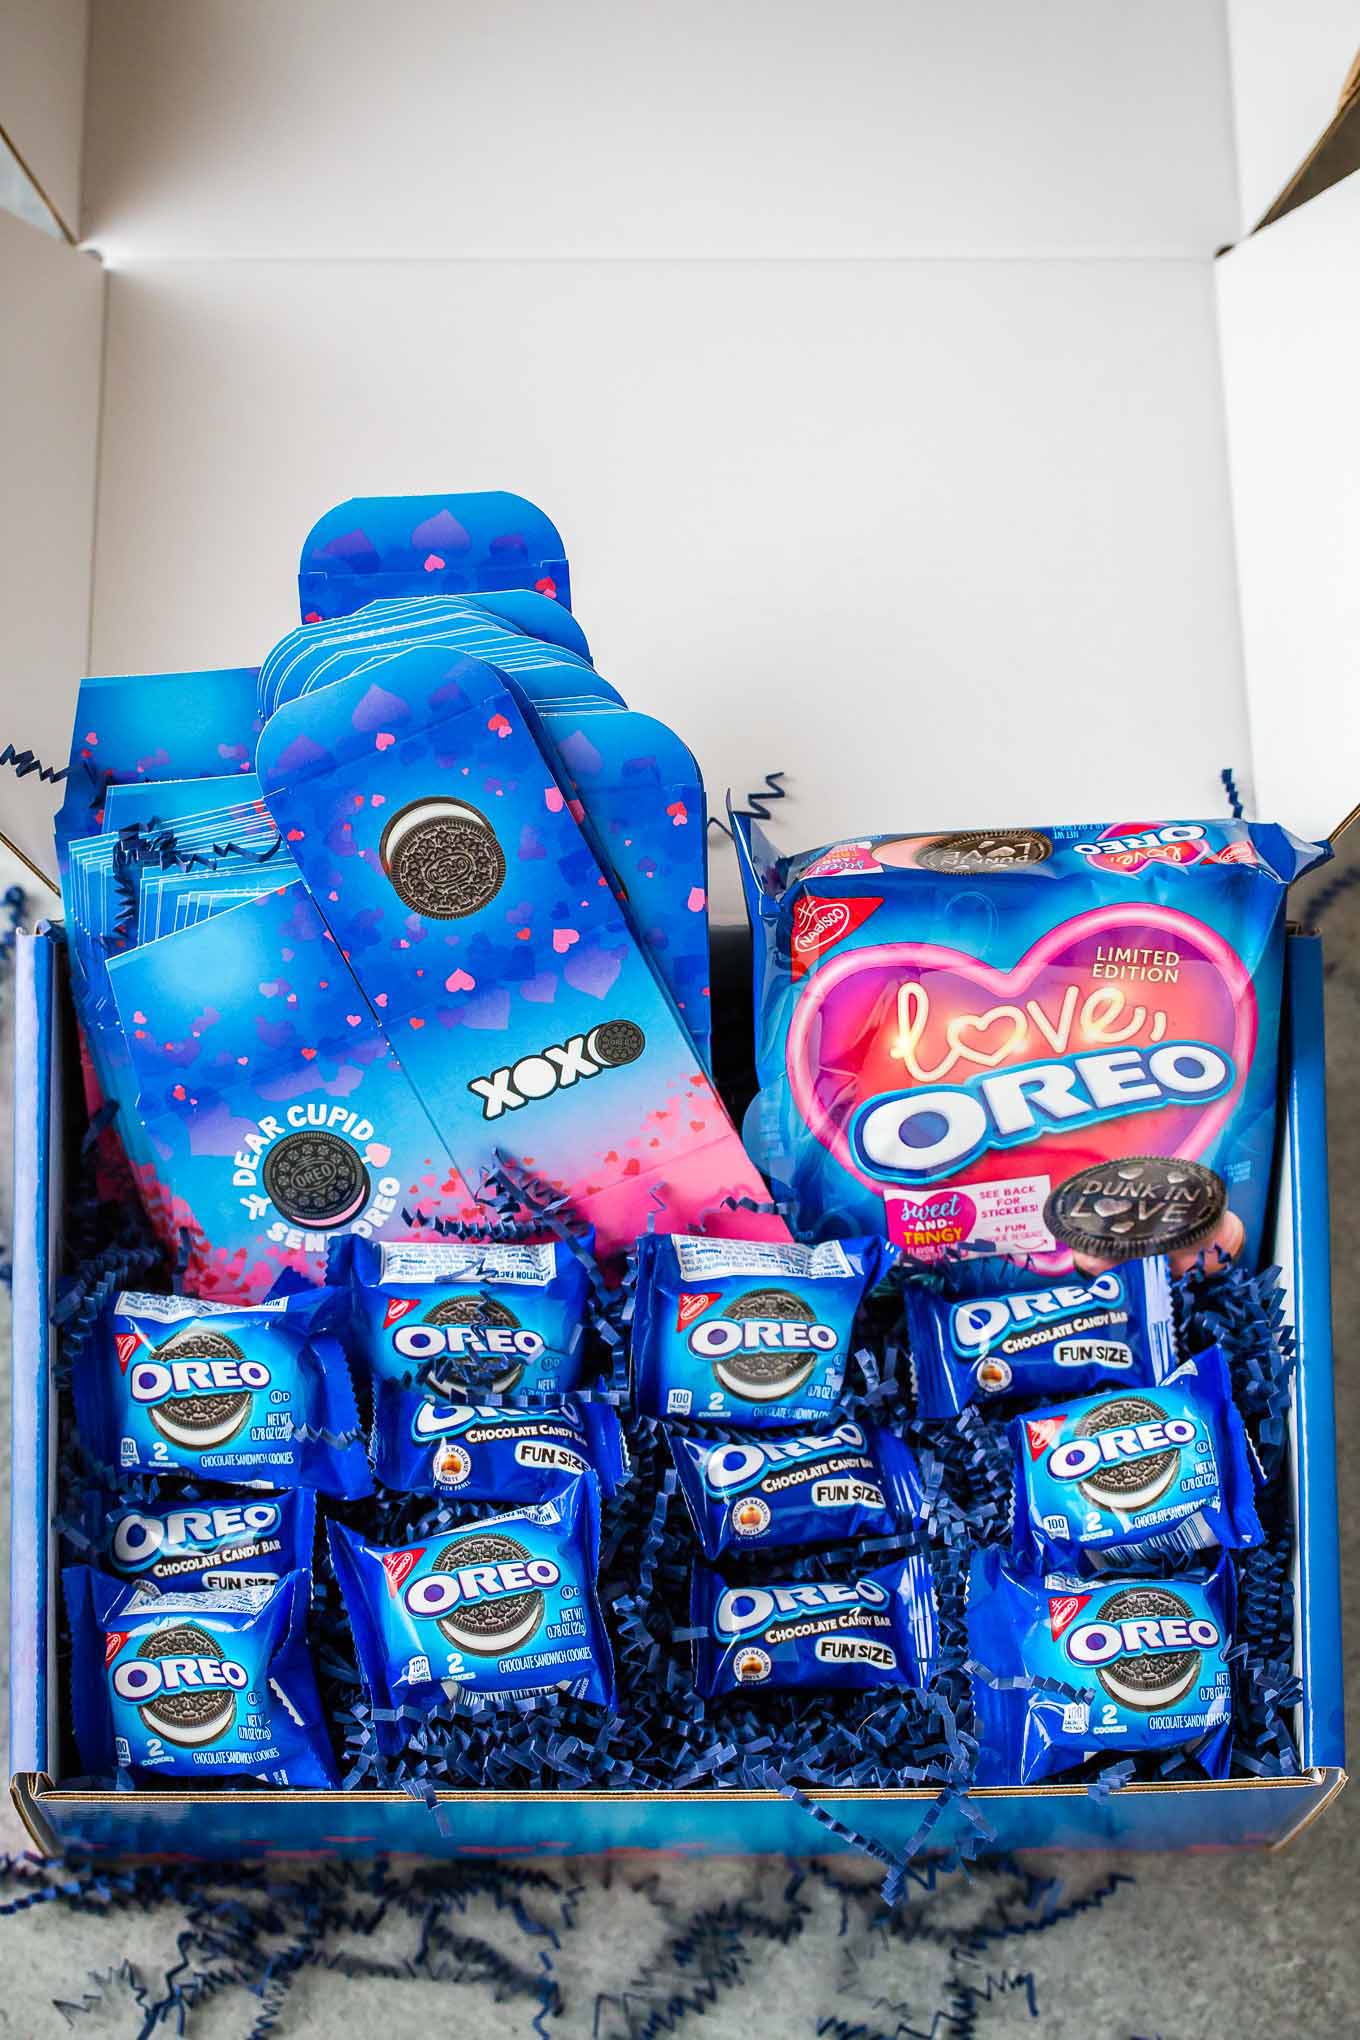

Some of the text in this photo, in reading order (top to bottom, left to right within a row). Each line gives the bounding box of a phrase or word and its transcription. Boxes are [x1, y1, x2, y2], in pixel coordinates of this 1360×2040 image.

[799, 907, 845, 947] NABISCO
[1096, 946, 1180, 967] LIMITED
[1092, 963, 1179, 983] EDITION
[861, 1044, 1227, 1171] OREO
[232, 1103, 375, 1187] DEAR CUPID
[294, 1163, 334, 1188] OREO
[1082, 1180, 1202, 1203] DUNK IN
[266, 1176, 401, 1253] SEN OREO
[902, 1194, 962, 1222] sweet
[903, 1226, 963, 1246] TANGY
[955, 1274, 1121, 1346] OREO
[393, 1325, 545, 1360] OREO
[691, 1320, 838, 1356] OREO
[1002, 1311, 1129, 1354] CHOCOLATE CANDY BAR
[1059, 1346, 1129, 1364] FUN SIZE
[131, 1360, 270, 1401] OREO
[672, 1392, 689, 1404] 100
[708, 1391, 725, 1411] 2
[267, 1413, 280, 1426] NET
[465, 1425, 538, 1442] CHOCOLATE
[539, 1424, 573, 1438] CANDY
[152, 1441, 169, 1461] 2
[201, 1451, 295, 1468] CHOCOLATE SANDWICH COOKIES
[520, 1444, 591, 1472] FUN SIZE
[707, 1424, 864, 1487] OREO
[1049, 1419, 1196, 1478] OREO
[761, 1465, 830, 1493] CHOCOLATE
[829, 1458, 861, 1474] CANDY
[816, 1486, 884, 1504] FUN SIZE
[1047, 1518, 1065, 1530] 100
[1086, 1511, 1104, 1532] 2
[1134, 1511, 1168, 1529] CHOCOLATE
[115, 1505, 276, 1562] OREO
[153, 1539, 281, 1578] CHOCOLATE CANDY BAR
[207, 1576, 242, 1590] FUN
[407, 1560, 560, 1615] OREO
[561, 1609, 574, 1623] NET
[718, 1580, 885, 1633] OREO
[547, 1625, 561, 1639] 0.78
[561, 1623, 572, 1637] OZ
[764, 1614, 892, 1644] CHOCOLATE CANDY BAR
[1068, 1618, 1219, 1664] OREO
[446, 1652, 465, 1675] 2
[499, 1646, 593, 1674] CHOCOLATE SANDWICH COOKIES
[821, 1643, 894, 1665] FUN SIZE
[411, 1659, 427, 1673] 100
[115, 1658, 247, 1699] OREO
[1216, 1672, 1228, 1686] NET
[1200, 1687, 1215, 1701] 0.78
[1101, 1704, 1118, 1725] 2
[1149, 1715, 1184, 1730] CHOCOLATE
[116, 1740, 128, 1753] 00
[146, 1738, 165, 1757] 2
[192, 1747, 280, 1765] CHOCOLATE SANDWICH COOKIES
